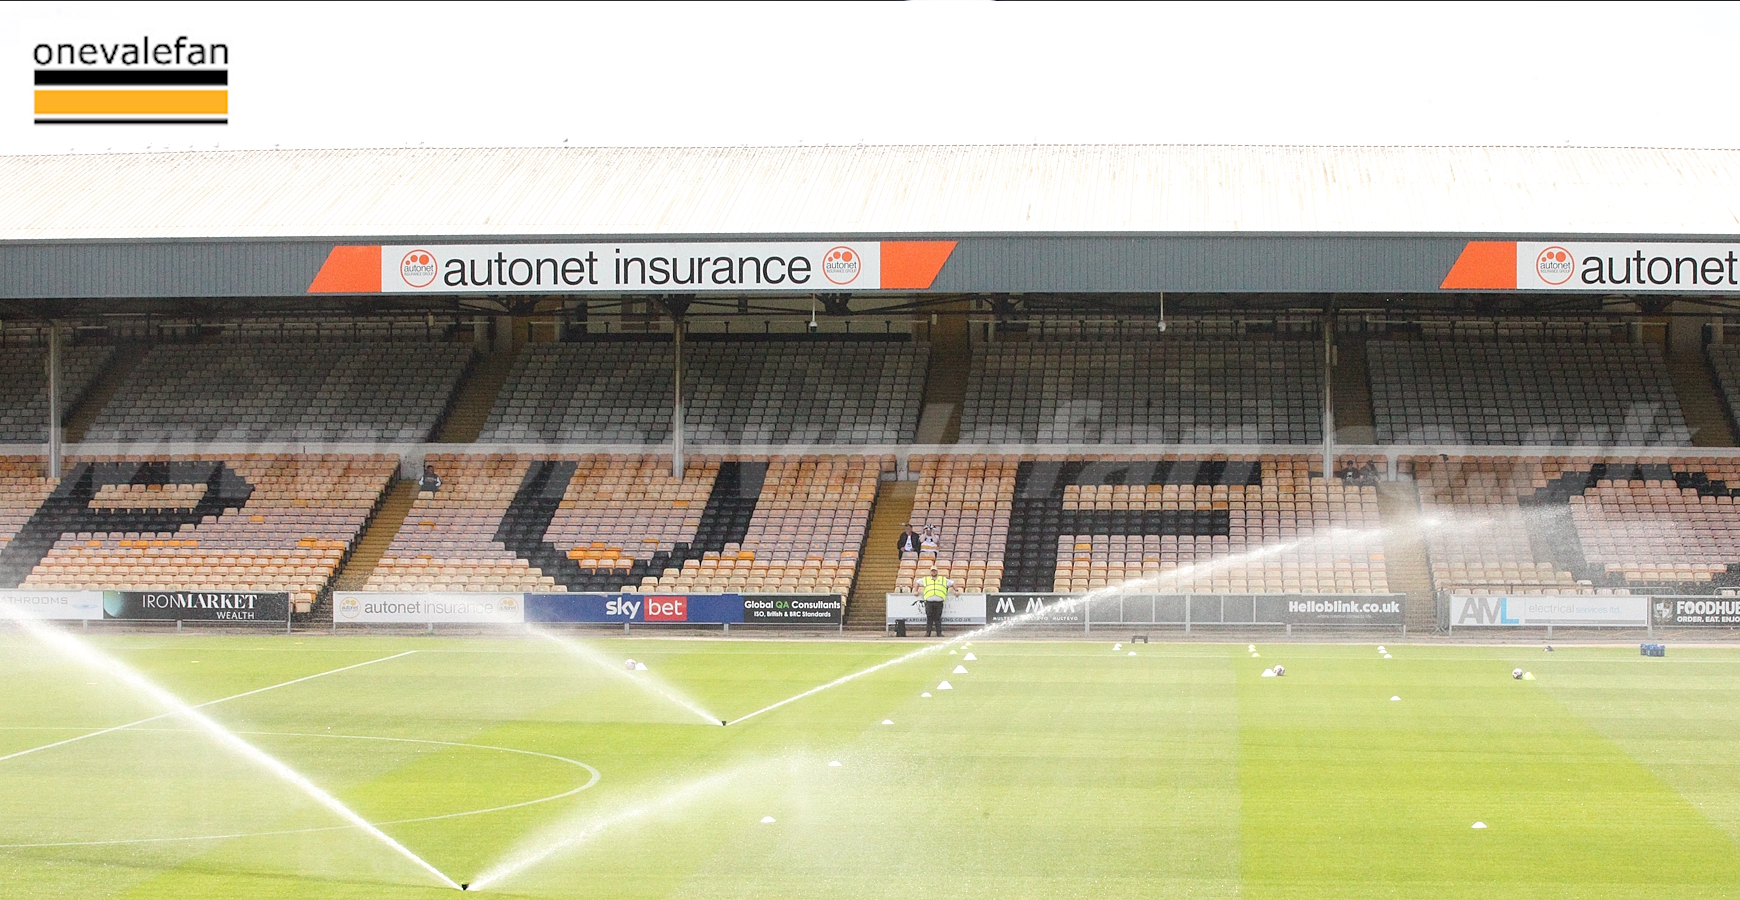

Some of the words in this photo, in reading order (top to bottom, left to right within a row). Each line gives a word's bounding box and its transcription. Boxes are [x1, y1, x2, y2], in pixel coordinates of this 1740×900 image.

[404, 264, 434, 272] autonet
[444, 251, 599, 287] autonet
[614, 248, 811, 286] insurance
[826, 261, 857, 269] autonet
[1540, 261, 1571, 269] autonet
[1581, 250, 1738, 285] autonet
[364, 601, 421, 614] autonet
[423, 600, 494, 614] insurance
[606, 597, 641, 619] sky
[648, 598, 683, 616] bet
[744, 600, 774, 609] Global
[775, 601, 789, 609] QA
[791, 600, 841, 609] Consultants
[1288, 601, 1400, 613] Helloblink.co.uk
[1457, 597, 1520, 624] AML
[1528, 603, 1575, 614] electrical
[1575, 605, 1608, 614] services
[216, 611, 255, 620] WEALTH
